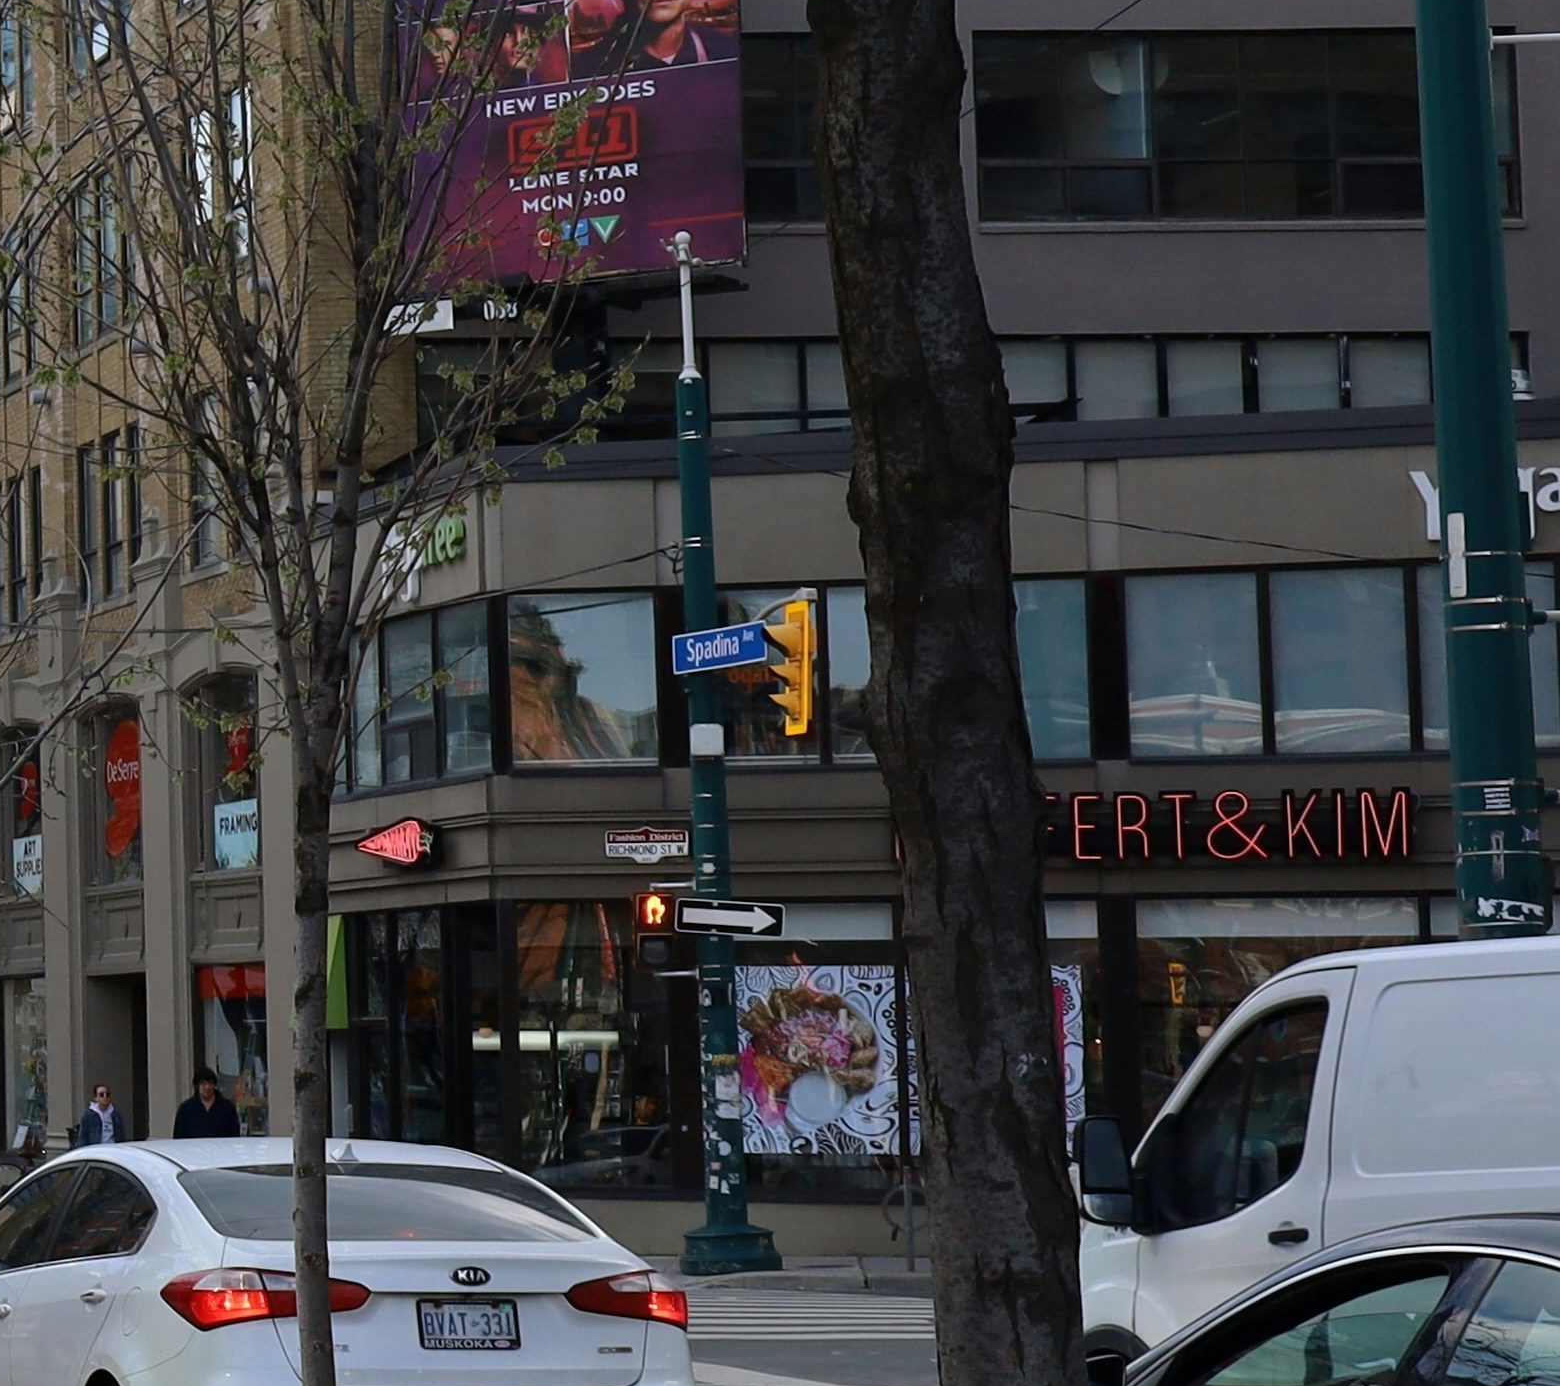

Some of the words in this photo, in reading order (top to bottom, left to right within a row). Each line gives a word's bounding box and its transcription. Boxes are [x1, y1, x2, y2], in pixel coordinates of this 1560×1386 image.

[485, 95, 537, 119] NEW
[579, 163, 639, 183] STAR
[522, 193, 573, 213] MON
[686, 633, 740, 667] Spadina
[742, 629, 755, 642] Ave
[219, 812, 258, 836] FRAMING
[609, 833, 646, 842] Fashion
[649, 832, 684, 842] District
[23, 840, 36, 859] ART
[608, 844, 658, 855] RICHMOND
[676, 844, 685, 854] W
[456, 1269, 487, 1282] KIA
[424, 1338, 494, 1349] MUSKOKA
